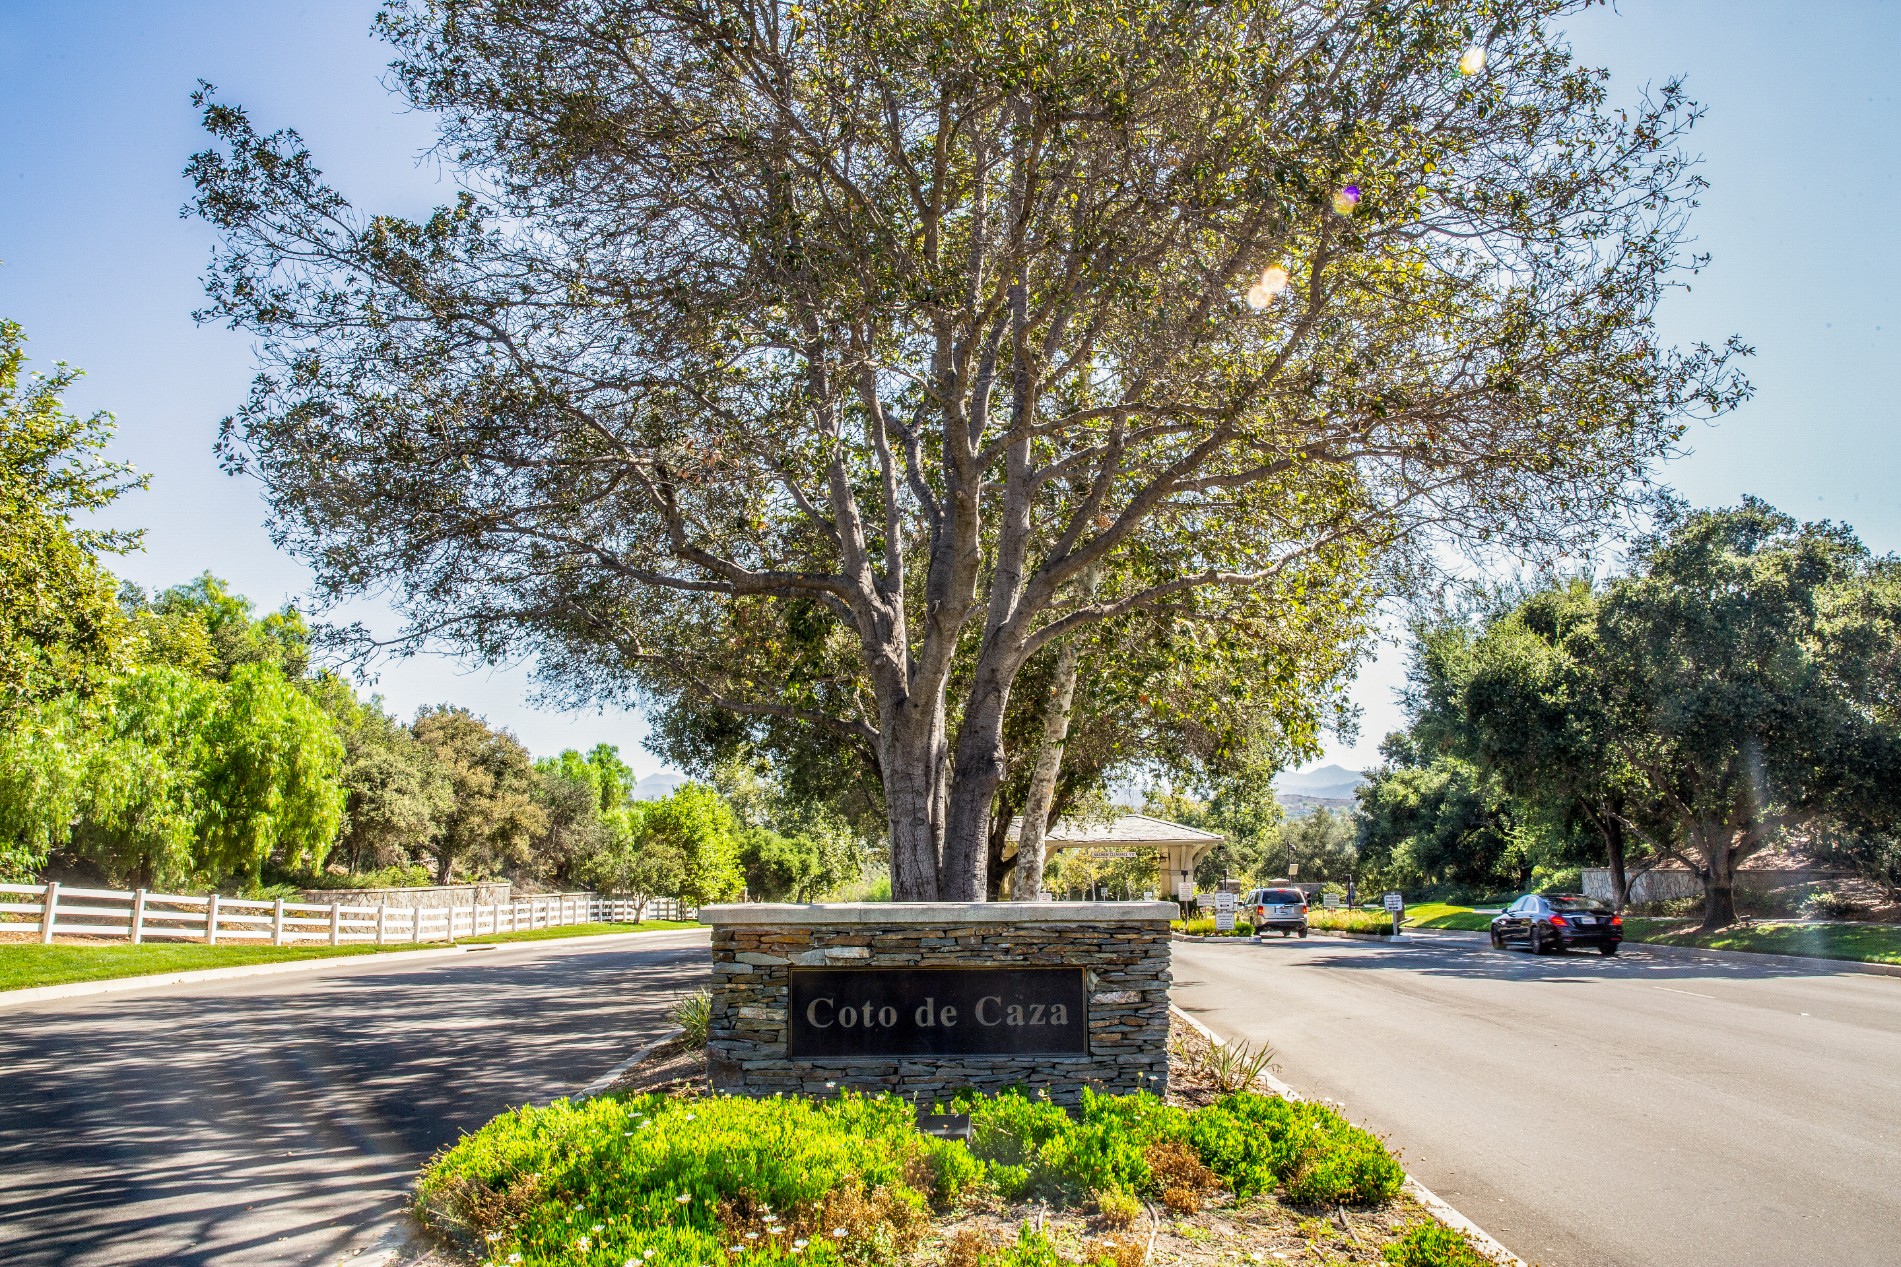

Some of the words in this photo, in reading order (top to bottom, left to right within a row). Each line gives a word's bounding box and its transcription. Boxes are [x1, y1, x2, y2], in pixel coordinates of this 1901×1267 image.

[806, 997, 898, 1028] Coto
[915, 997, 957, 1027] de
[975, 996, 1069, 1026] Caza
